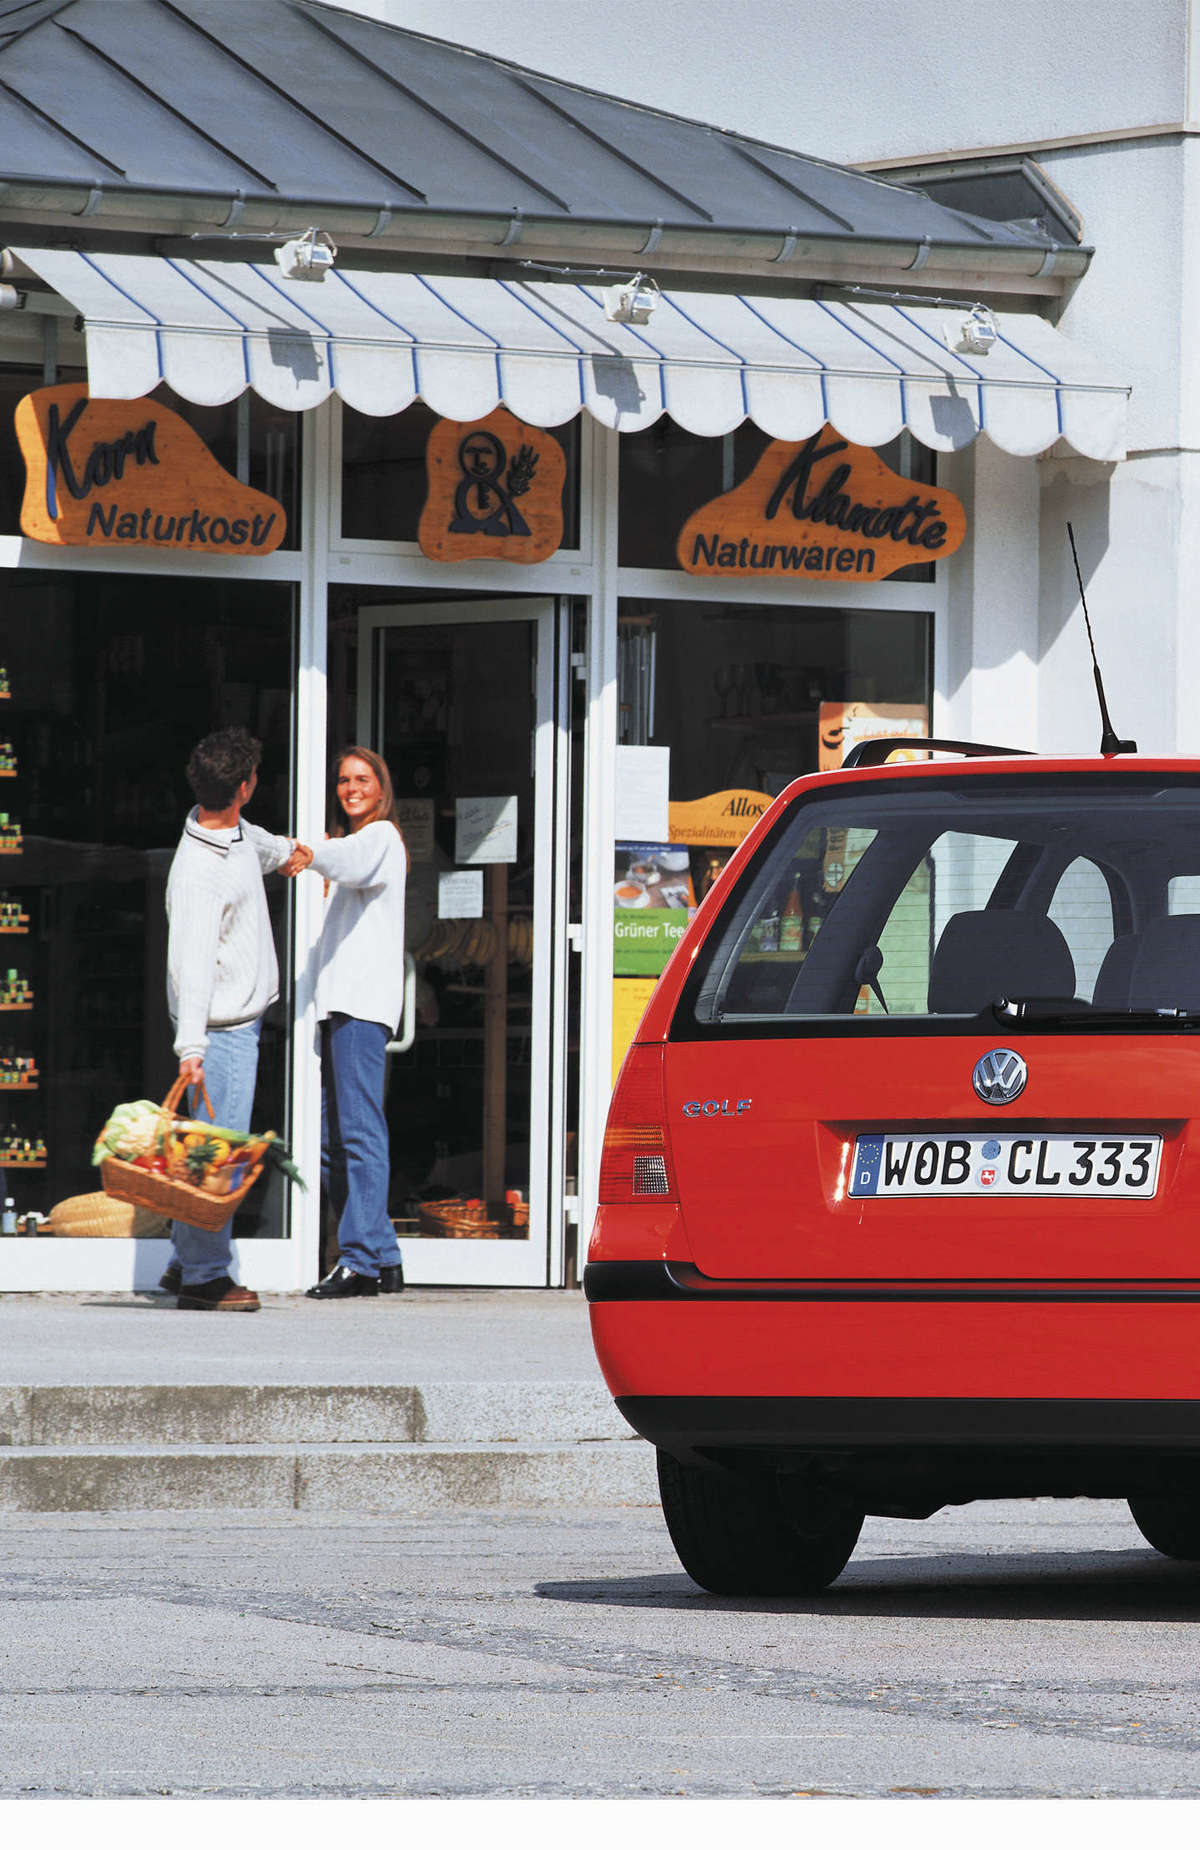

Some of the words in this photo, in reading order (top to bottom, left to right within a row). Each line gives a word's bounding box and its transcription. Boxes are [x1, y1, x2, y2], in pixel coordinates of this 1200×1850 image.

[46, 398, 160, 520] Korn
[765, 431, 948, 550] Klamotte
[691, 533, 876, 573] Naturwaren
[721, 797, 765, 818] Allos
[669, 824, 737, 840] Spezialitäten
[615, 921, 659, 938] Grüner
[663, 922, 685, 938] Tee
[682, 1099, 752, 1117] GOLF
[884, 1140, 972, 1186] WOB
[860, 1171, 871, 1185] D
